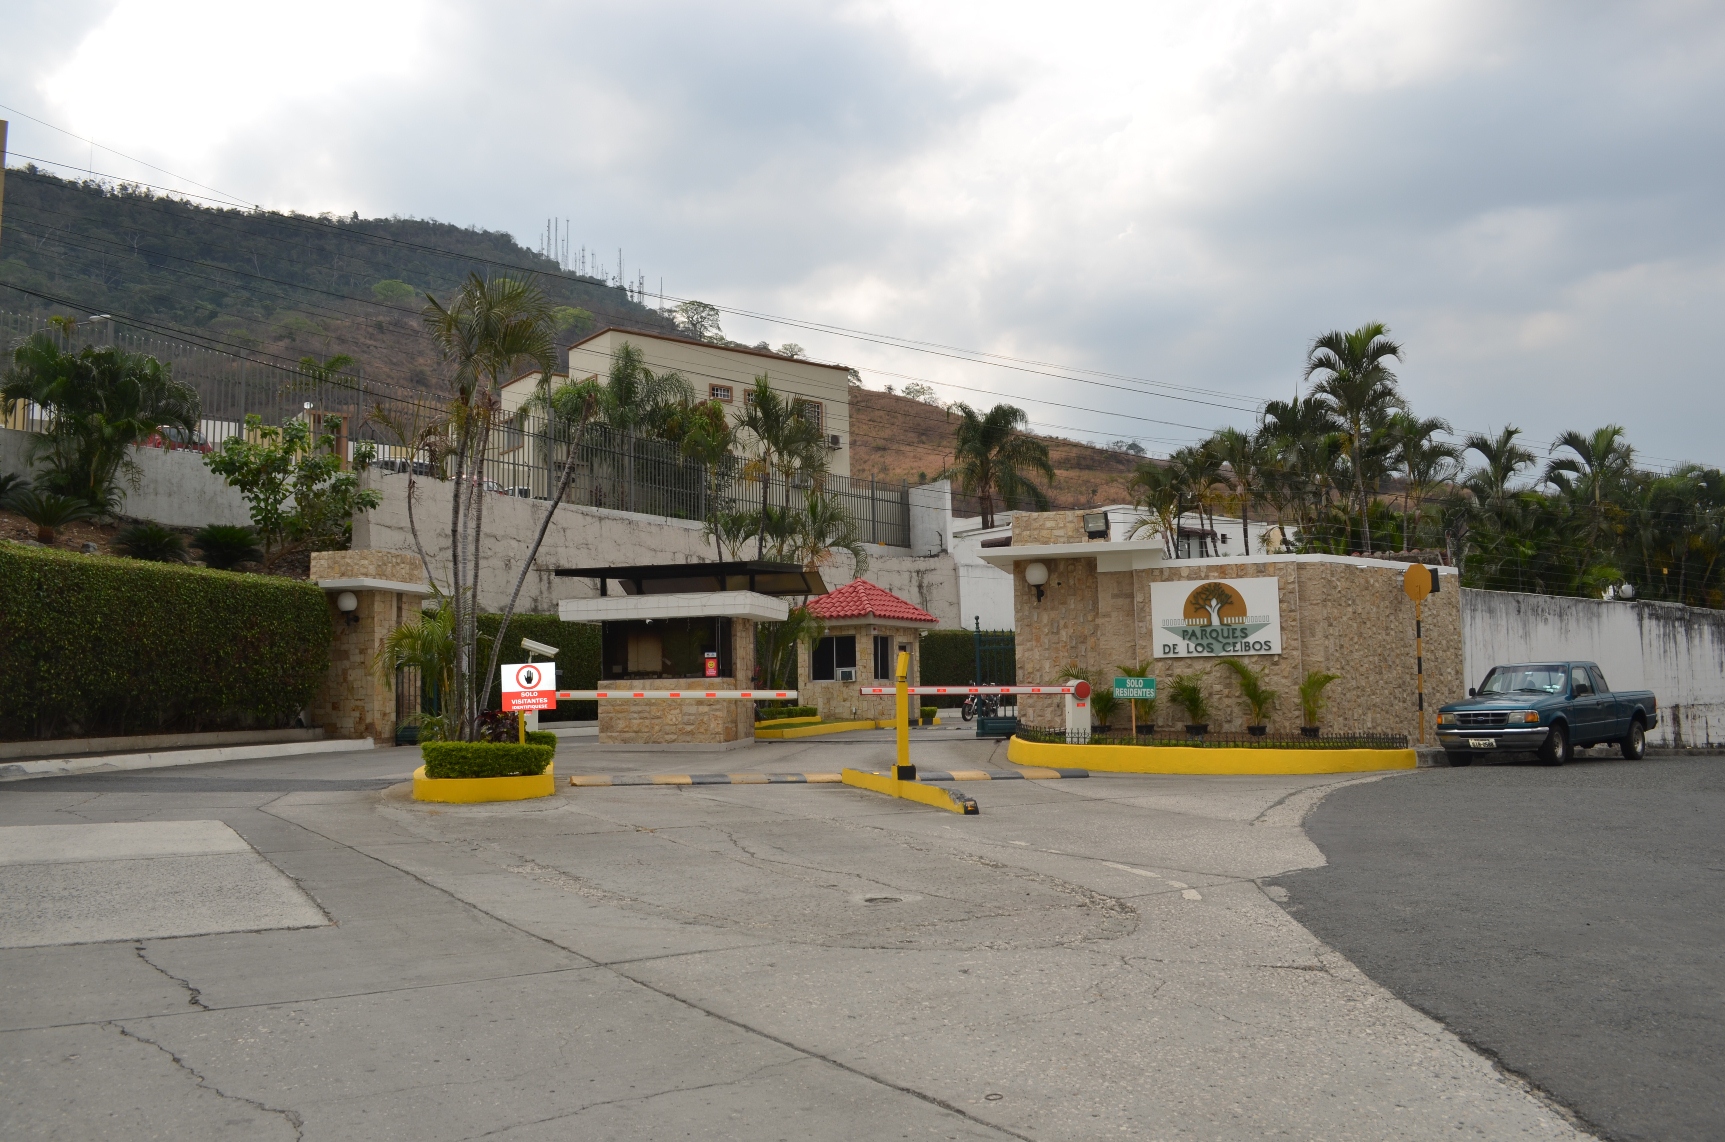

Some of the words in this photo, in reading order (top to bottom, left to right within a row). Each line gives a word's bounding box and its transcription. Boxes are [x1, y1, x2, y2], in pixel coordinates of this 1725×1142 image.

[1182, 627, 1248, 643] PARQUES
[1163, 643, 1179, 655] DE
[1187, 642, 1214, 653] LOS
[1222, 640, 1272, 653] CEIBOS
[1126, 679, 1144, 688] SOLO
[1115, 687, 1155, 697] RESIDENTES
